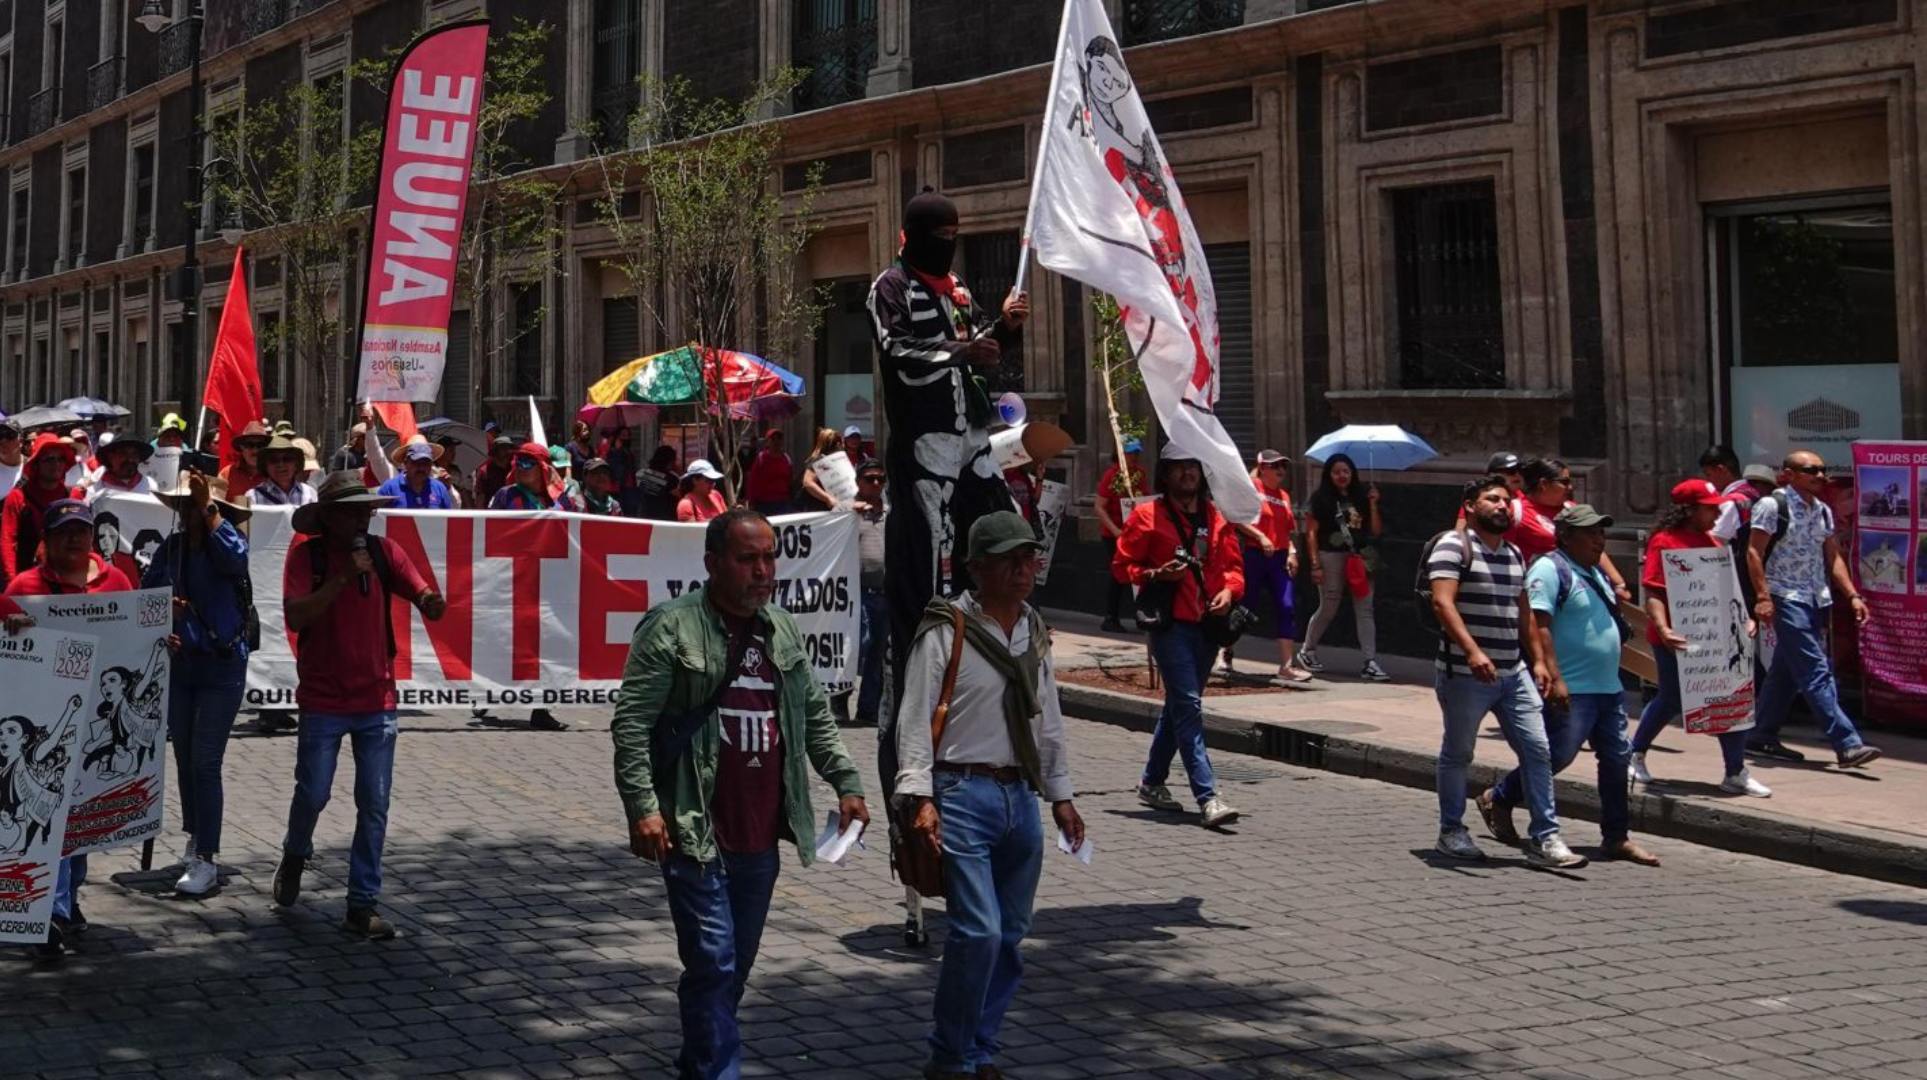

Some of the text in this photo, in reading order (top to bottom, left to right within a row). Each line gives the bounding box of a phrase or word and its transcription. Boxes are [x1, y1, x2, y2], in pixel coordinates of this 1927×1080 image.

[1869, 453, 1910, 464] TOURS
[773, 524, 812, 559] DOS
[284, 515, 653, 681] NTE
[48, 601, 118, 618] Sección 9
[22, 637, 34, 652] 9
[56, 658, 90, 675] 2024
[246, 688, 621, 708] QUI IERNE, LOS DEREC
[0, 920, 46, 935] CEREMOS!
